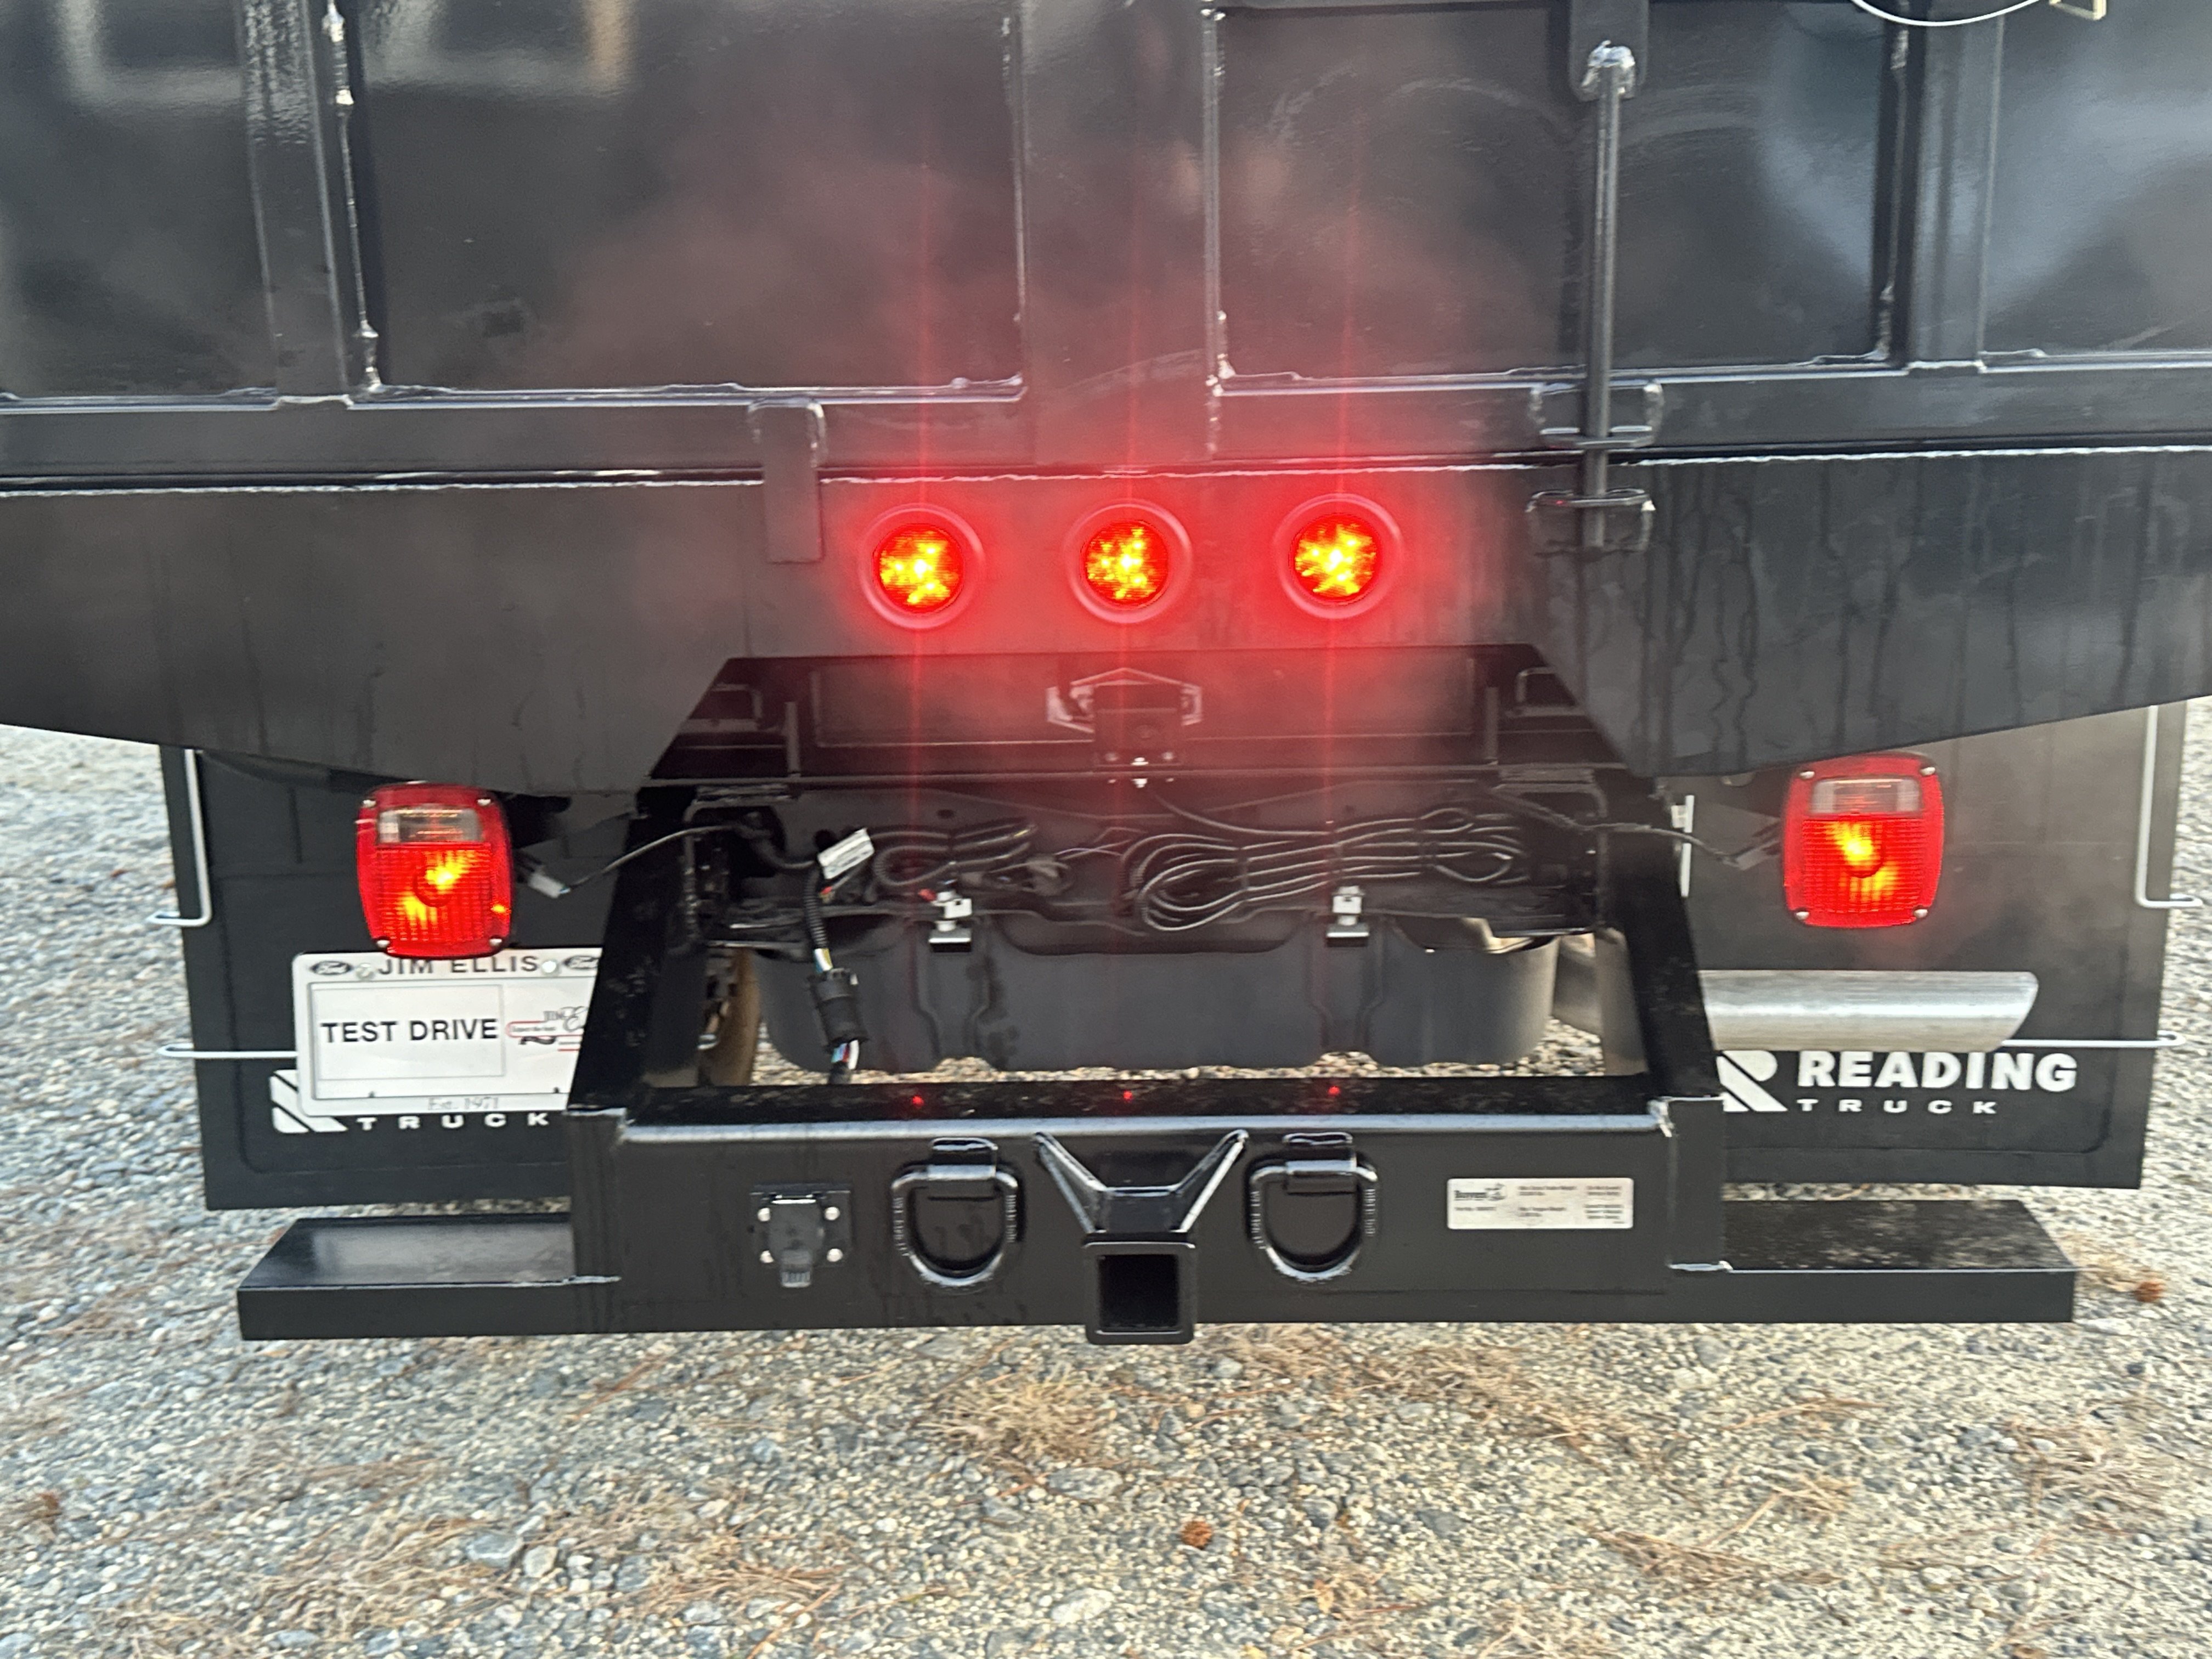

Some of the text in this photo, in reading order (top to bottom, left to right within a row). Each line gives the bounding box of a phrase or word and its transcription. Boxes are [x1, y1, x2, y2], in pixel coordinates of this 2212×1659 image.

[378, 956, 539, 975] JIM ELLIS
[320, 1018, 498, 1043] TEST DRIVE
[1797, 1051, 2077, 1092] READING
[1796, 1099, 1997, 1114] TRUCK
[356, 1113, 549, 1131] TRUCK
